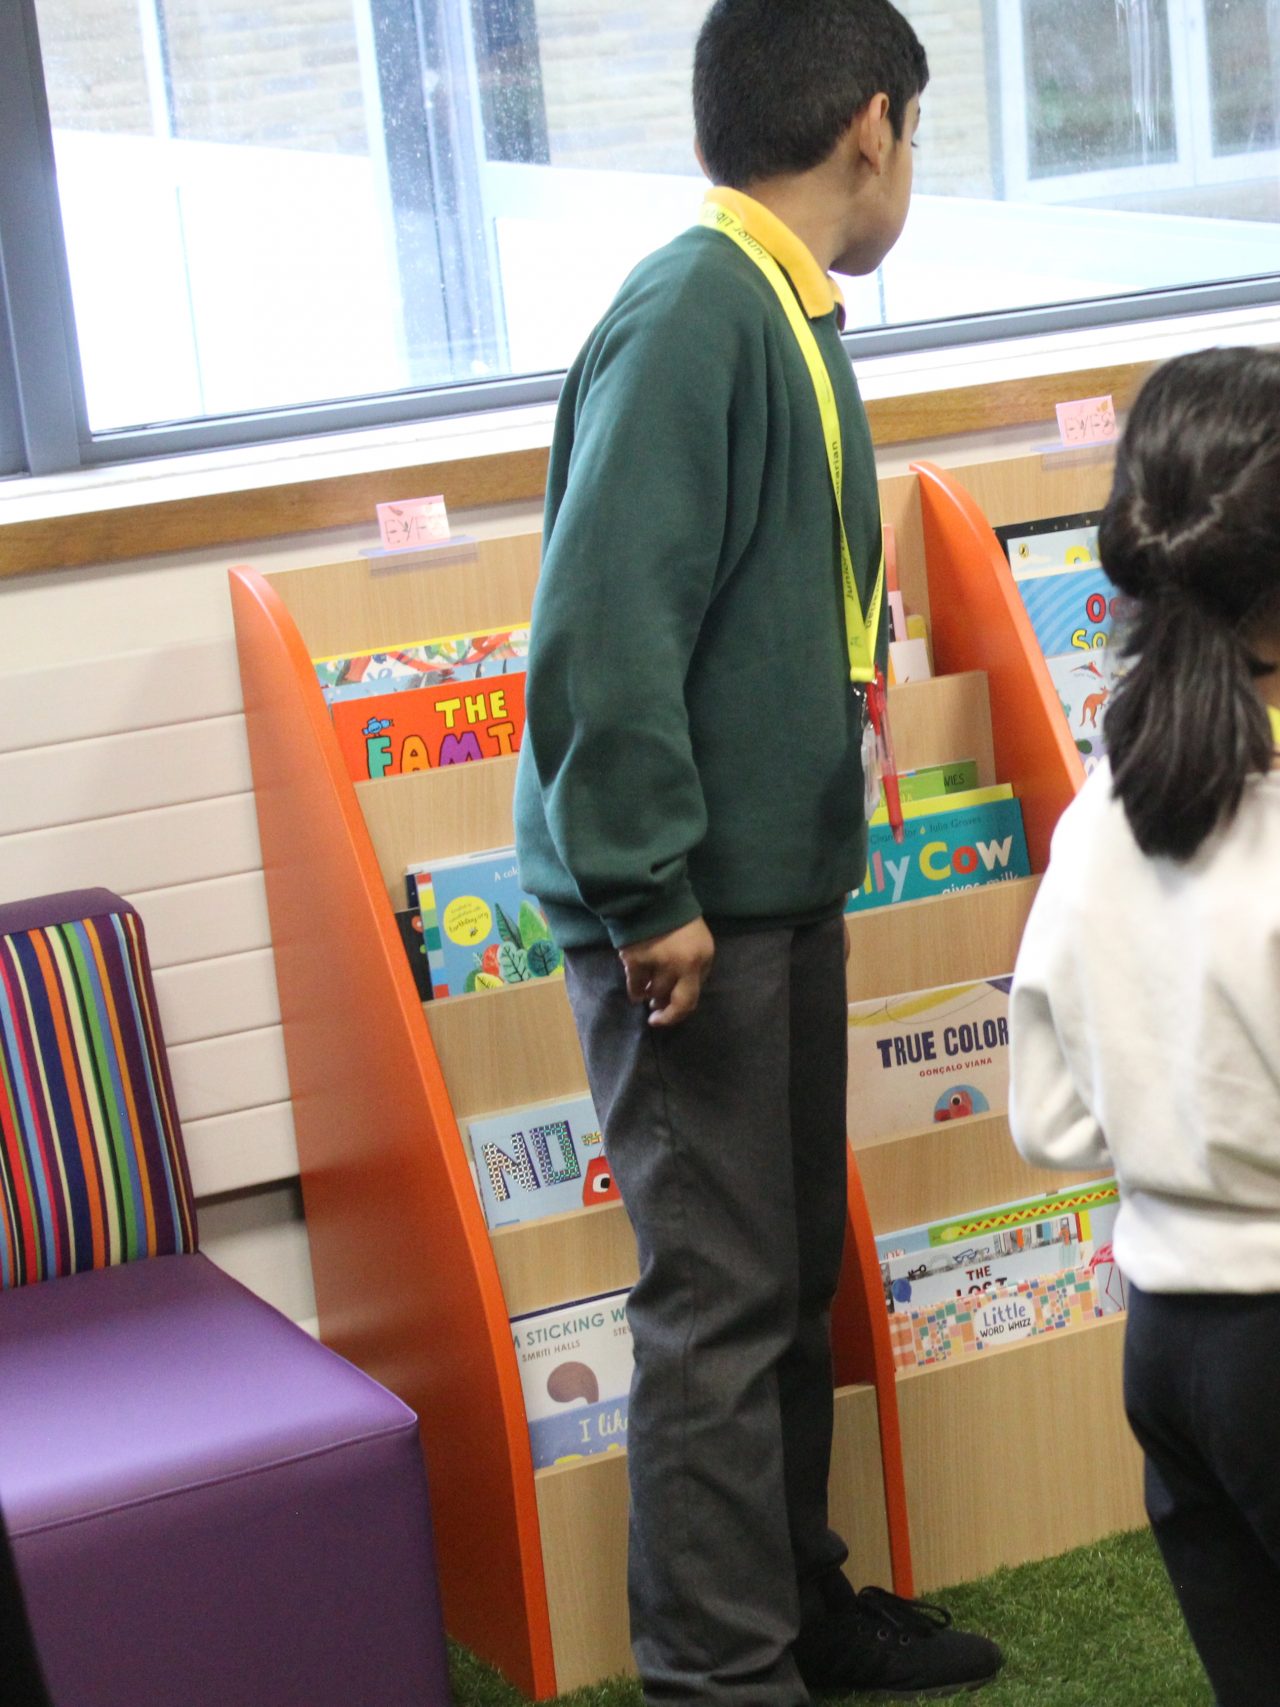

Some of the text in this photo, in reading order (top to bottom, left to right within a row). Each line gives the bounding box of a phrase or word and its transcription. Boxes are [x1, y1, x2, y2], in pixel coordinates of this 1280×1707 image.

[435, 690, 508, 728] THE
[365, 721, 522, 780] FAMI
[919, 834, 1013, 881] Cow
[876, 1016, 1010, 1070] TRUE COLOR
[919, 1057, 993, 1078] GONÇALO VIANA
[965, 1265, 992, 1281] THE
[979, 1317, 1032, 1338] WORD WHIZZ
[983, 1301, 1027, 1328] Little
[527, 1313, 605, 1348] STICKING
[522, 1339, 582, 1363] SMRITI HALLS
[579, 1418, 592, 1443] I
